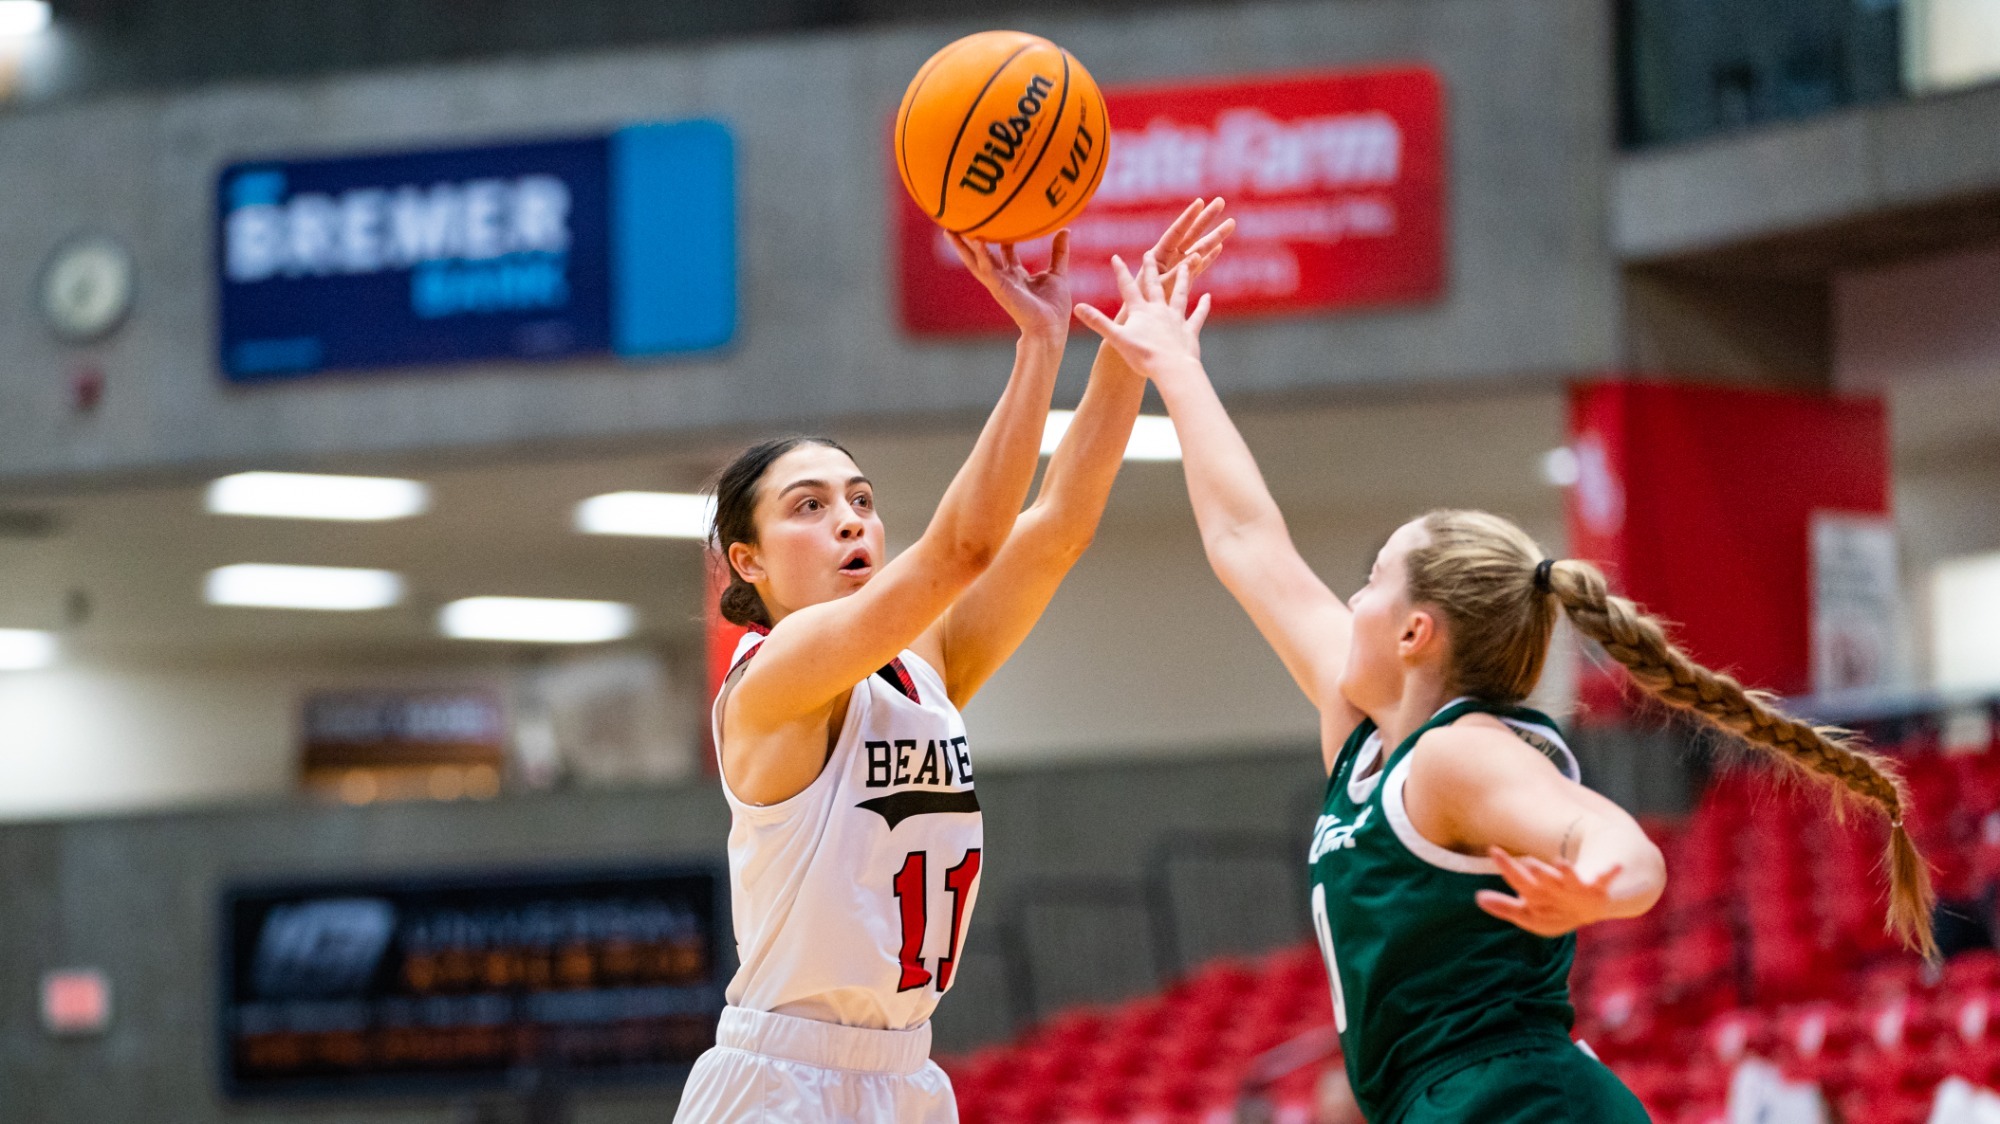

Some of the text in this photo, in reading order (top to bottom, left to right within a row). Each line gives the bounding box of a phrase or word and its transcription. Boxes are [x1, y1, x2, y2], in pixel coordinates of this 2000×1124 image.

[960, 74, 1053, 196] Wilson
[1045, 125, 1093, 208] EVO
[226, 175, 571, 283] BREMER
[893, 848, 981, 993] 11
